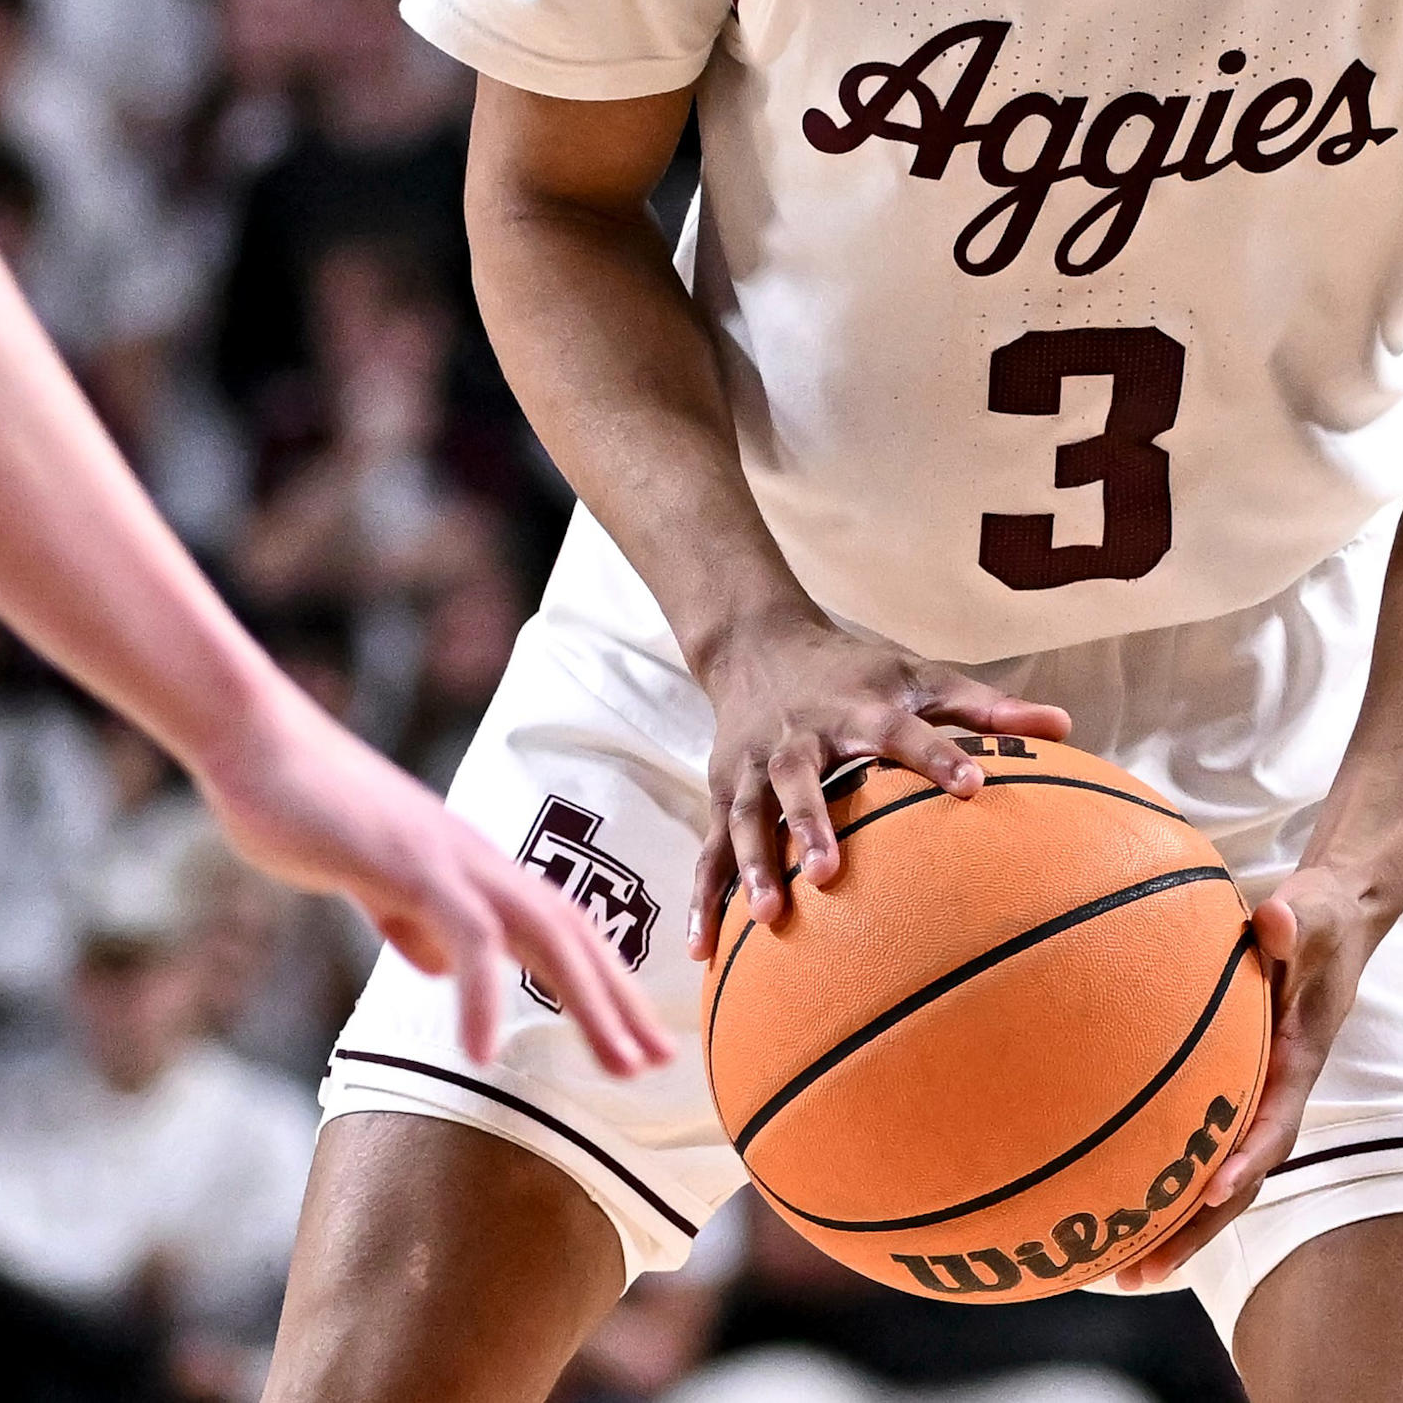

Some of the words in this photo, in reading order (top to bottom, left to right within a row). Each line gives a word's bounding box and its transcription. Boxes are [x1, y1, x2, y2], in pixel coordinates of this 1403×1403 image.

[801, 20, 1398, 277] Aggies
[979, 326, 1186, 591] 3
[889, 1094, 1239, 1295] Wilson
